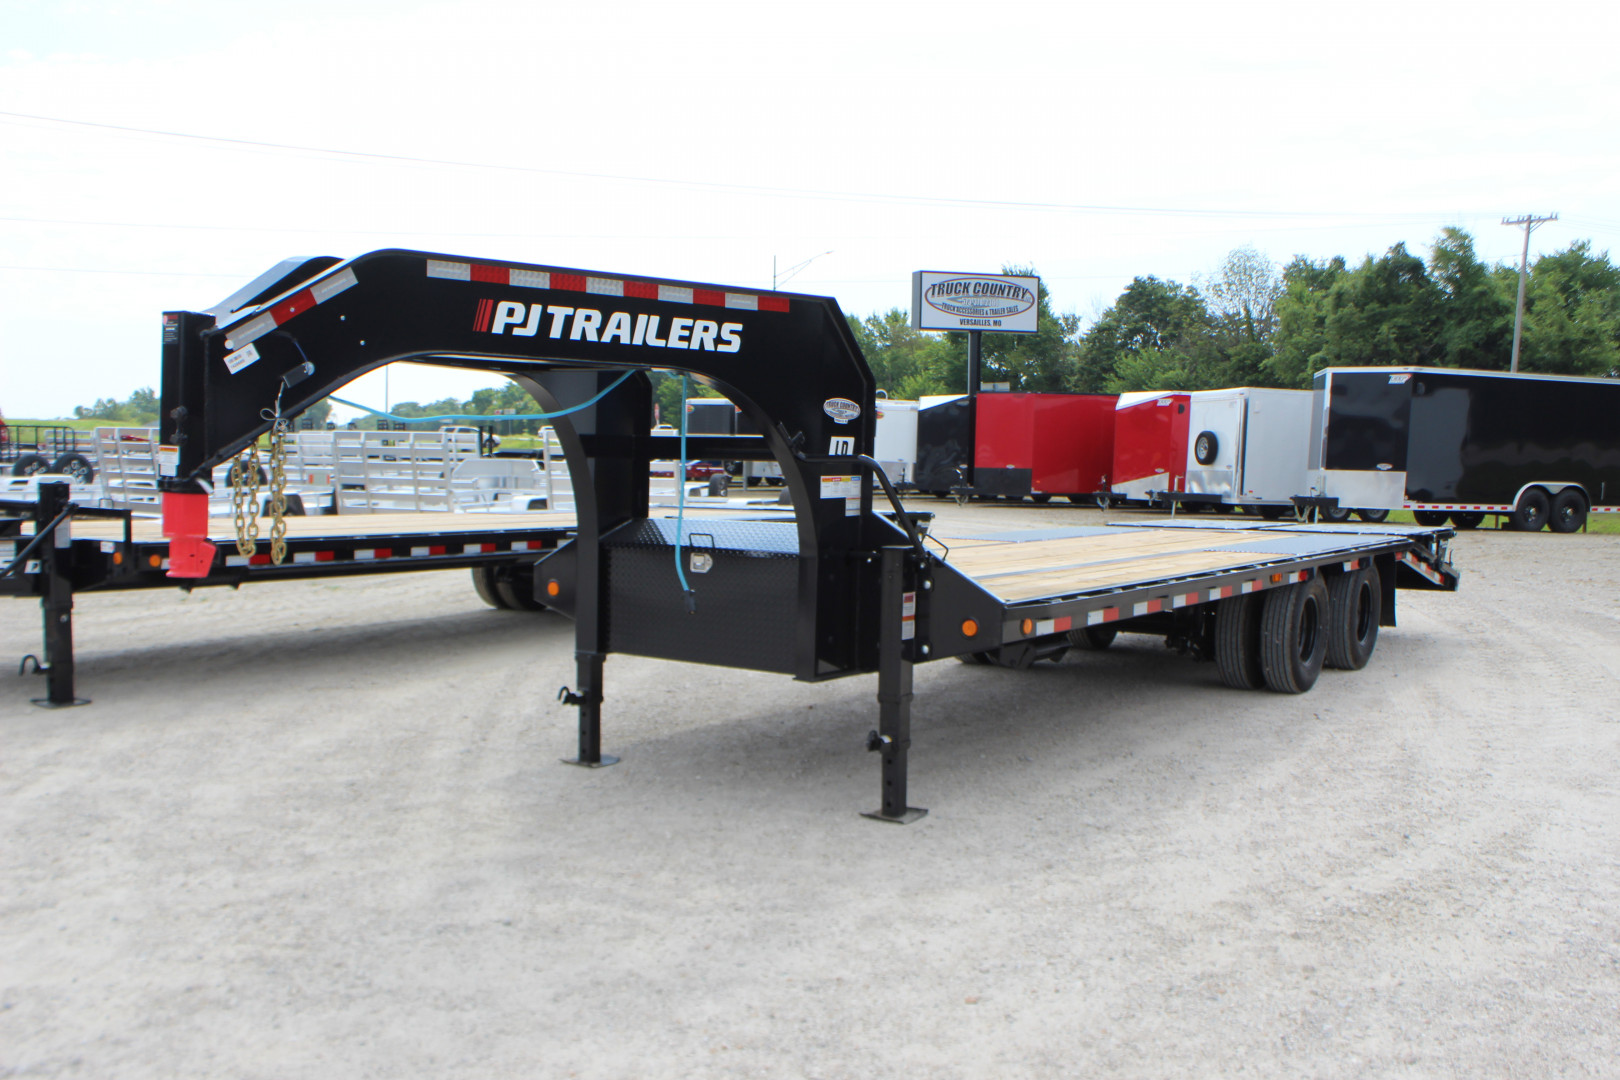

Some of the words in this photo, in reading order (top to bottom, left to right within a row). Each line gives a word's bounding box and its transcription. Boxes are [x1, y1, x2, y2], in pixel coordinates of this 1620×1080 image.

[931, 281, 971, 296] TRUCK
[973, 282, 1029, 299] COUNTRY
[941, 302, 955, 312] TRUCK
[956, 304, 985, 316] ACCESSORIES
[989, 306, 1006, 316] TRAILER
[1006, 304, 1019, 314] SALES
[491, 300, 543, 337] PJ
[546, 305, 743, 353] TRAILERS
[993, 319, 1002, 327] MO
